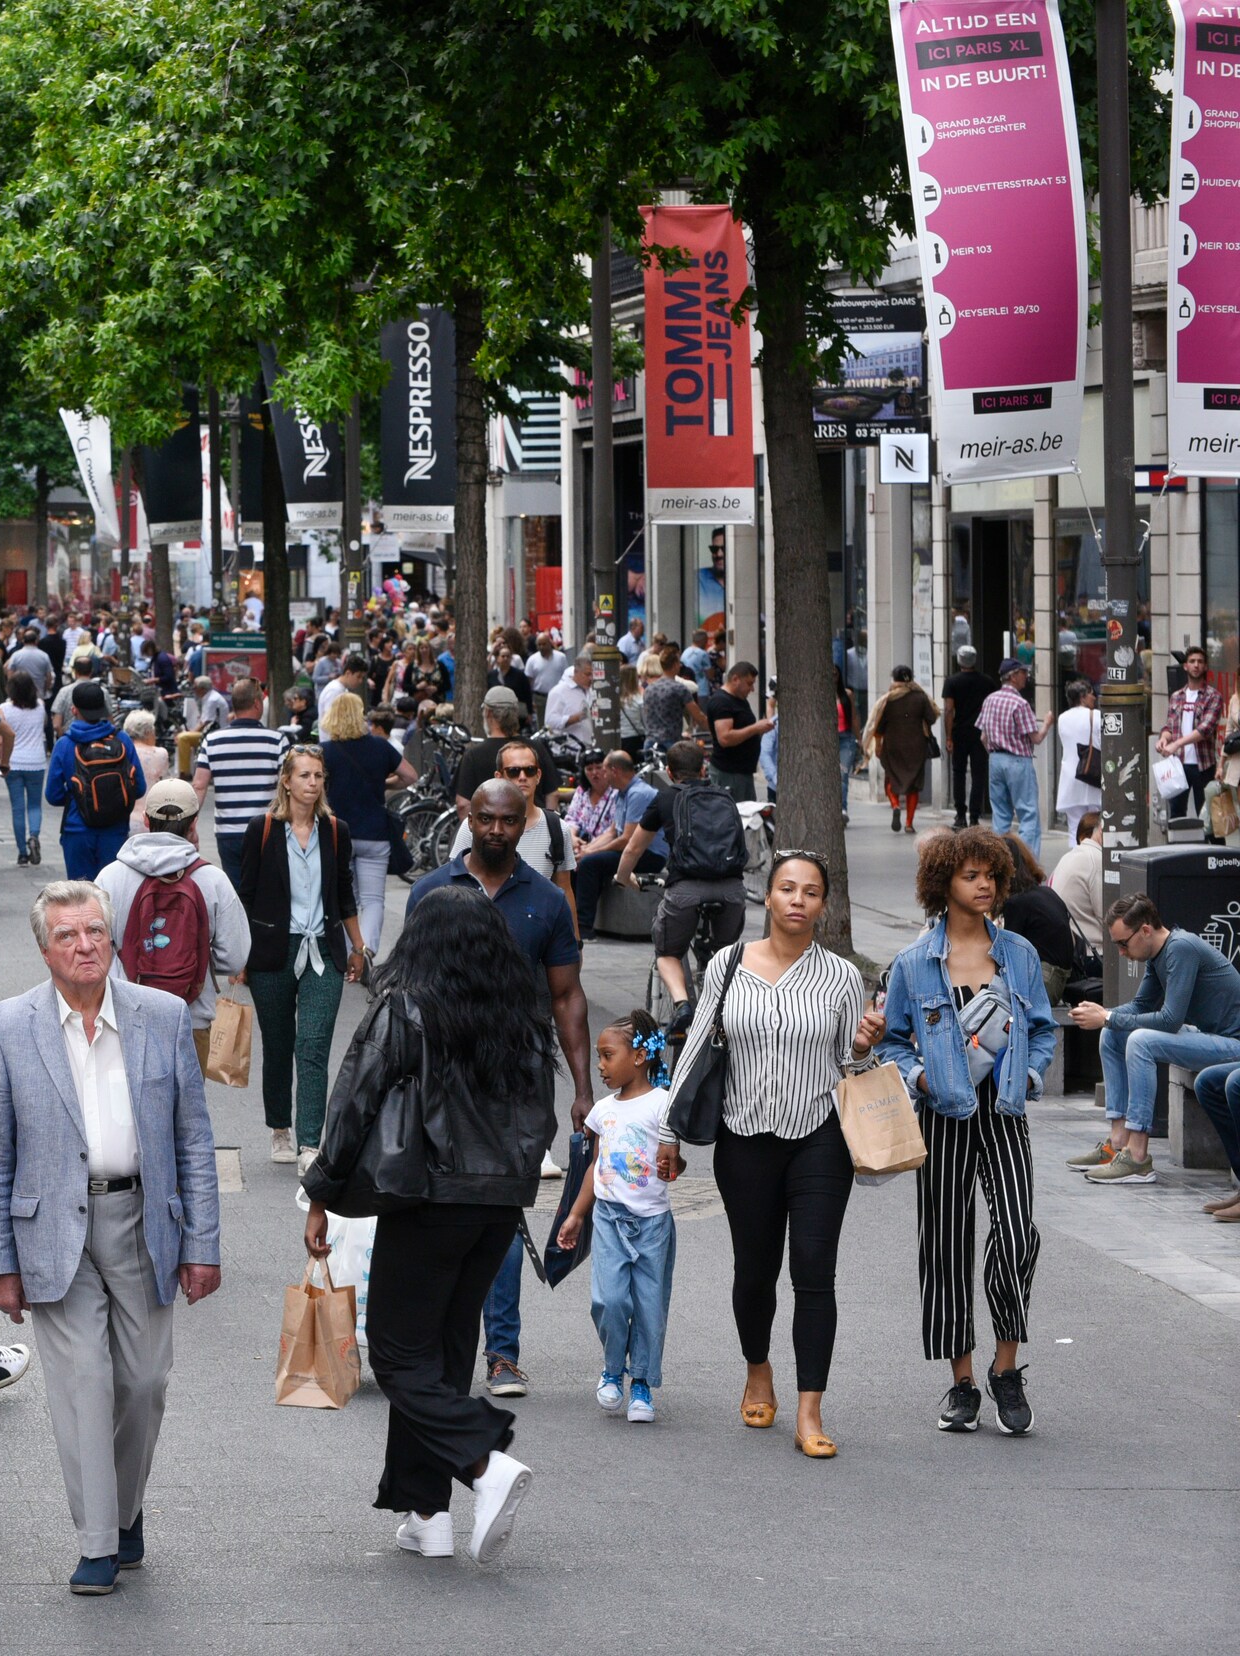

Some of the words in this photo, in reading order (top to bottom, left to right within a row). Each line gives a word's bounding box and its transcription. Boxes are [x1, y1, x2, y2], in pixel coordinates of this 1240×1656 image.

[916, 15, 988, 35] ALTIJD
[995, 13, 1037, 27] EEN
[1208, 31, 1228, 46] ICI
[928, 47, 951, 61] ICI
[955, 41, 1002, 58] PARIS
[1008, 40, 1030, 52] XL
[1197, 60, 1215, 76] IN
[921, 77, 940, 92] IN
[945, 73, 972, 89] DE
[976, 65, 1047, 85] BUURT!
[1204, 109, 1239, 119] GRAND
[936, 119, 971, 130] GRAND
[973, 114, 1006, 126] BAZAR
[937, 127, 986, 140] SHOPPING
[988, 122, 1027, 134] CENTER
[944, 176, 1053, 195] HUIDEVETTERSSTRAAT
[1055, 175, 1067, 185] 53
[951, 247, 975, 256] MEIR
[976, 245, 992, 254] 103
[1199, 242, 1223, 250] MEIR
[704, 251, 733, 360] JEANS
[891, 297, 916, 306] DAMS
[958, 306, 1009, 318] KEYSERLEI
[1013, 305, 1040, 315] 28/30
[404, 321, 438, 489] NESPRESSO
[981, 397, 996, 408] ICI
[999, 395, 1029, 407] PARIS
[1033, 394, 1045, 404] XL
[1211, 394, 1227, 404] ICI
[855, 428, 867, 438] 03
[960, 431, 1063, 459] meir-as.be
[661, 496, 741, 509] meir-as.be
[296, 508, 337, 519] meir-as.be
[392, 511, 449, 522] meir-as.be
[859, 1094, 902, 1115] PRIMARK
